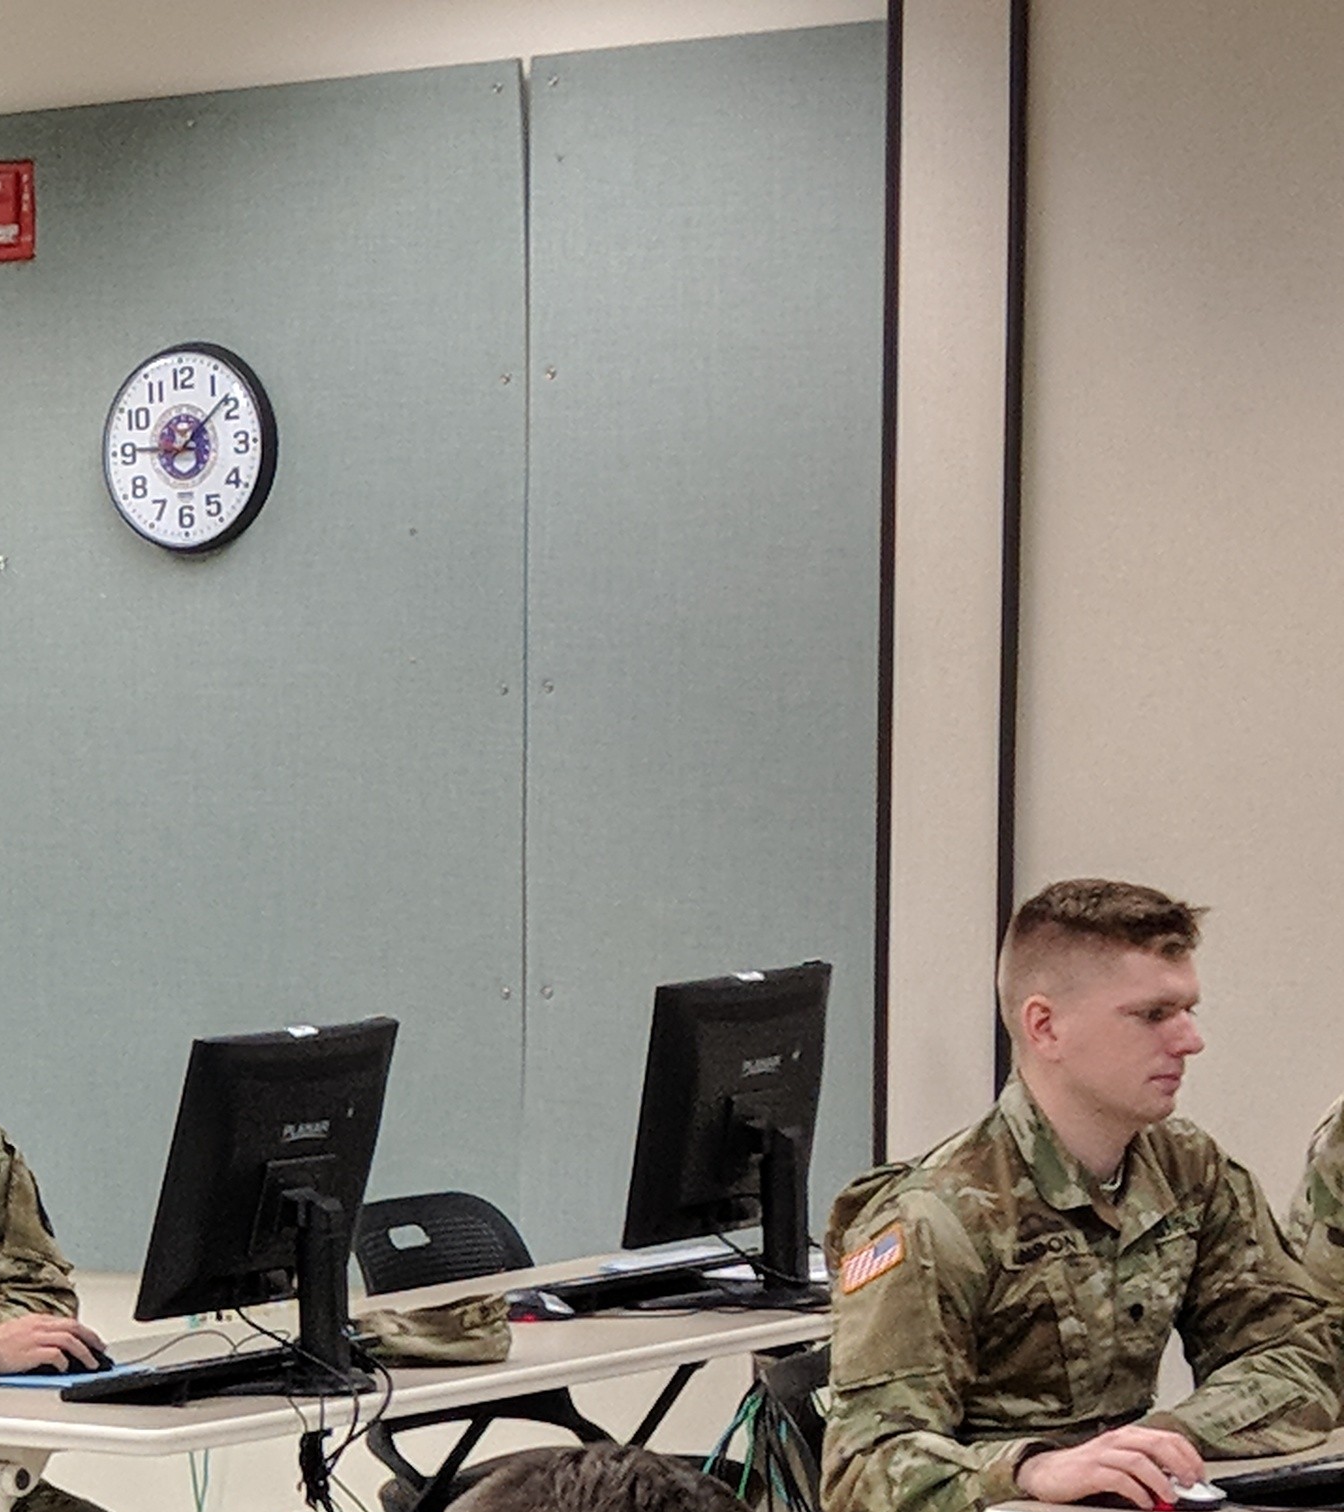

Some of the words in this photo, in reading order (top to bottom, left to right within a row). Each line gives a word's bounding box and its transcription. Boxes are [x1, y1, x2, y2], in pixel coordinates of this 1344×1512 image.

[173, 366, 195, 391] 12
[210, 374, 216, 397] 1
[148, 380, 164, 404] 11
[127, 407, 150, 431] 10
[224, 396, 240, 421] 2
[120, 442, 138, 465] 9
[232, 431, 250, 454] 3
[131, 475, 148, 499] 8
[225, 467, 241, 488] 4
[151, 499, 167, 521] 7
[178, 505, 195, 529] 6
[205, 494, 222, 517] 5
